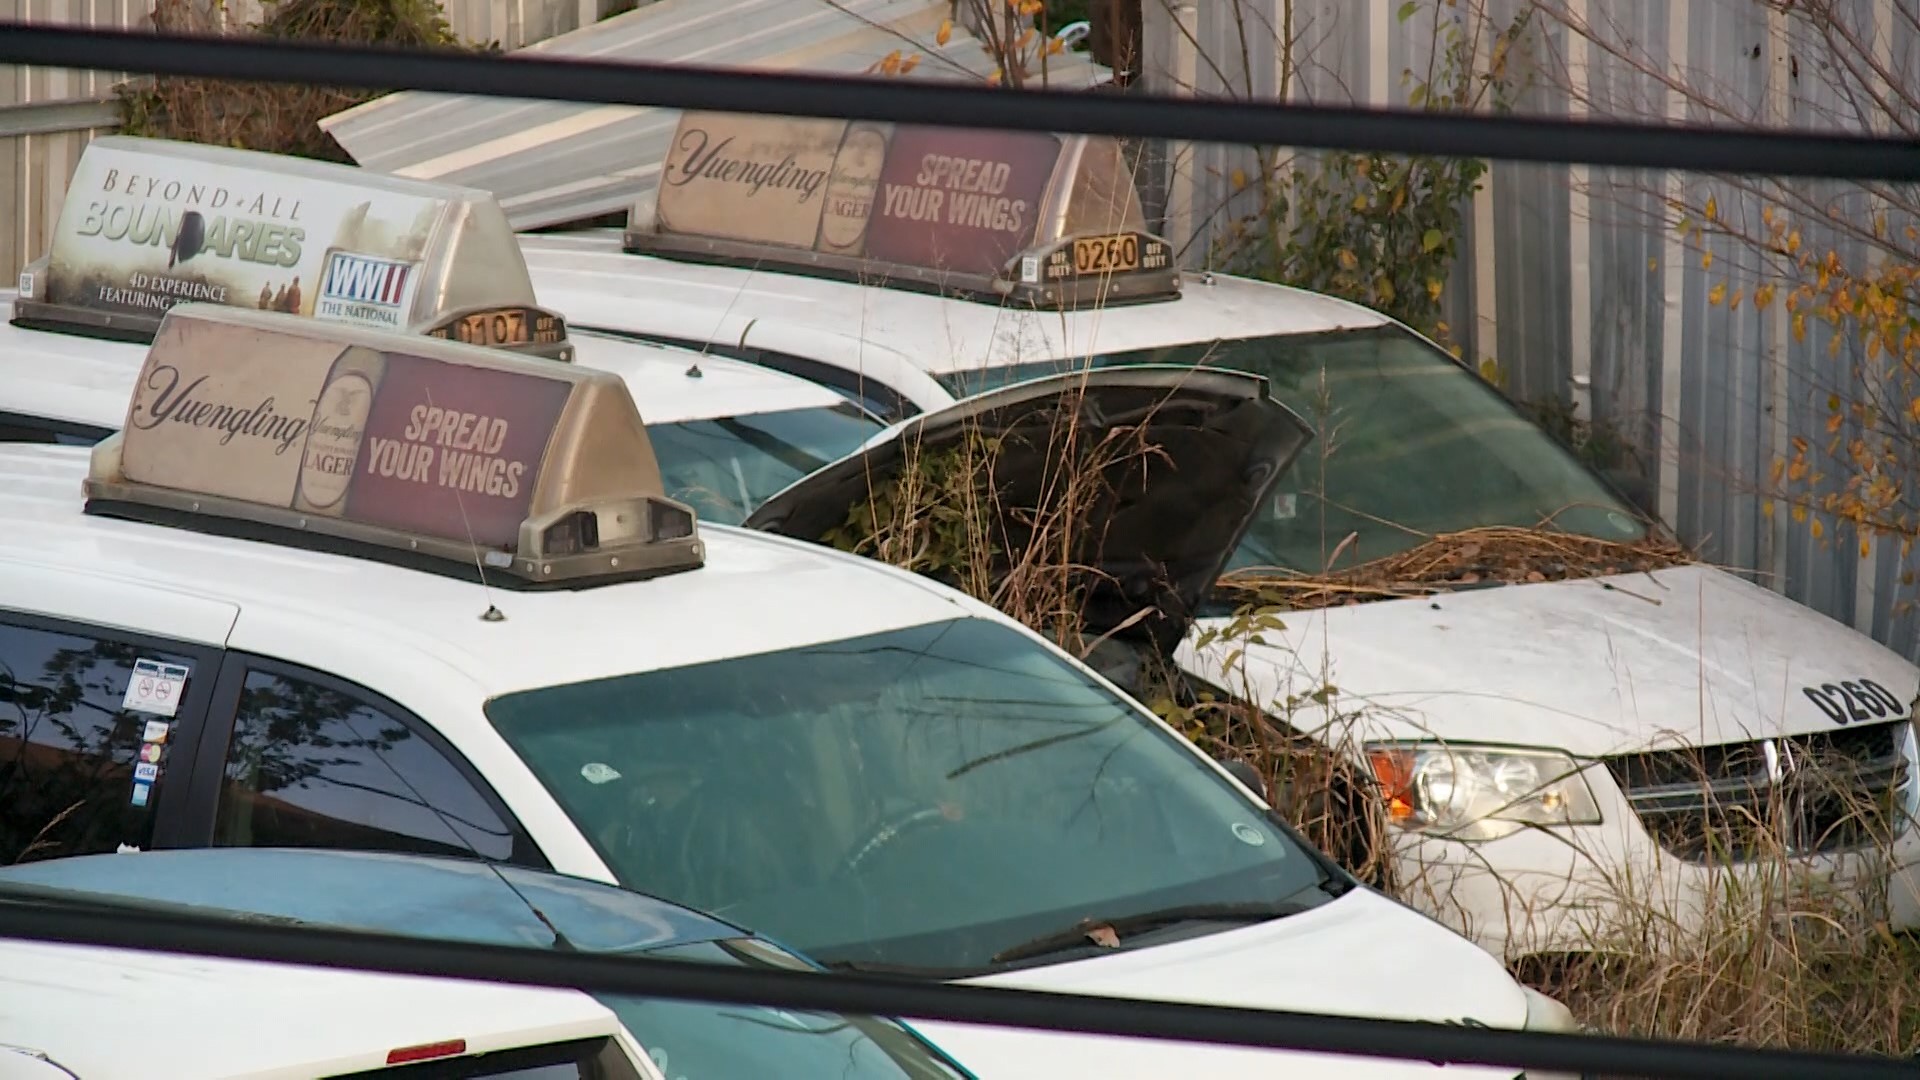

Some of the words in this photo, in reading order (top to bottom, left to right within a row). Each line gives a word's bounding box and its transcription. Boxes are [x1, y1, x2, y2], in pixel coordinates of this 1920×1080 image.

[665, 128, 827, 204] Yuengling
[916, 153, 1011, 194] SPREAD
[102, 168, 229, 209] BEYOND
[248, 191, 302, 221] ALL
[824, 198, 869, 218] AGER
[883, 183, 944, 222] YOUR
[947, 191, 1026, 232] WINGS
[76, 198, 306, 268] BOUNARIES
[1075, 237, 1137, 271] 0260
[99, 285, 170, 310] FEATURING
[129, 271, 148, 289] 4D
[151, 276, 227, 302] EXPERIENCE
[327, 255, 407, 305] WWII
[322, 301, 342, 316] THE
[345, 305, 398, 326] NATIONAL
[132, 365, 308, 455] Yuengling
[404, 404, 508, 454] SPREAD
[367, 436, 434, 484] YOUR
[438, 448, 523, 498] WINGS
[1802, 678, 1904, 725] 0260
